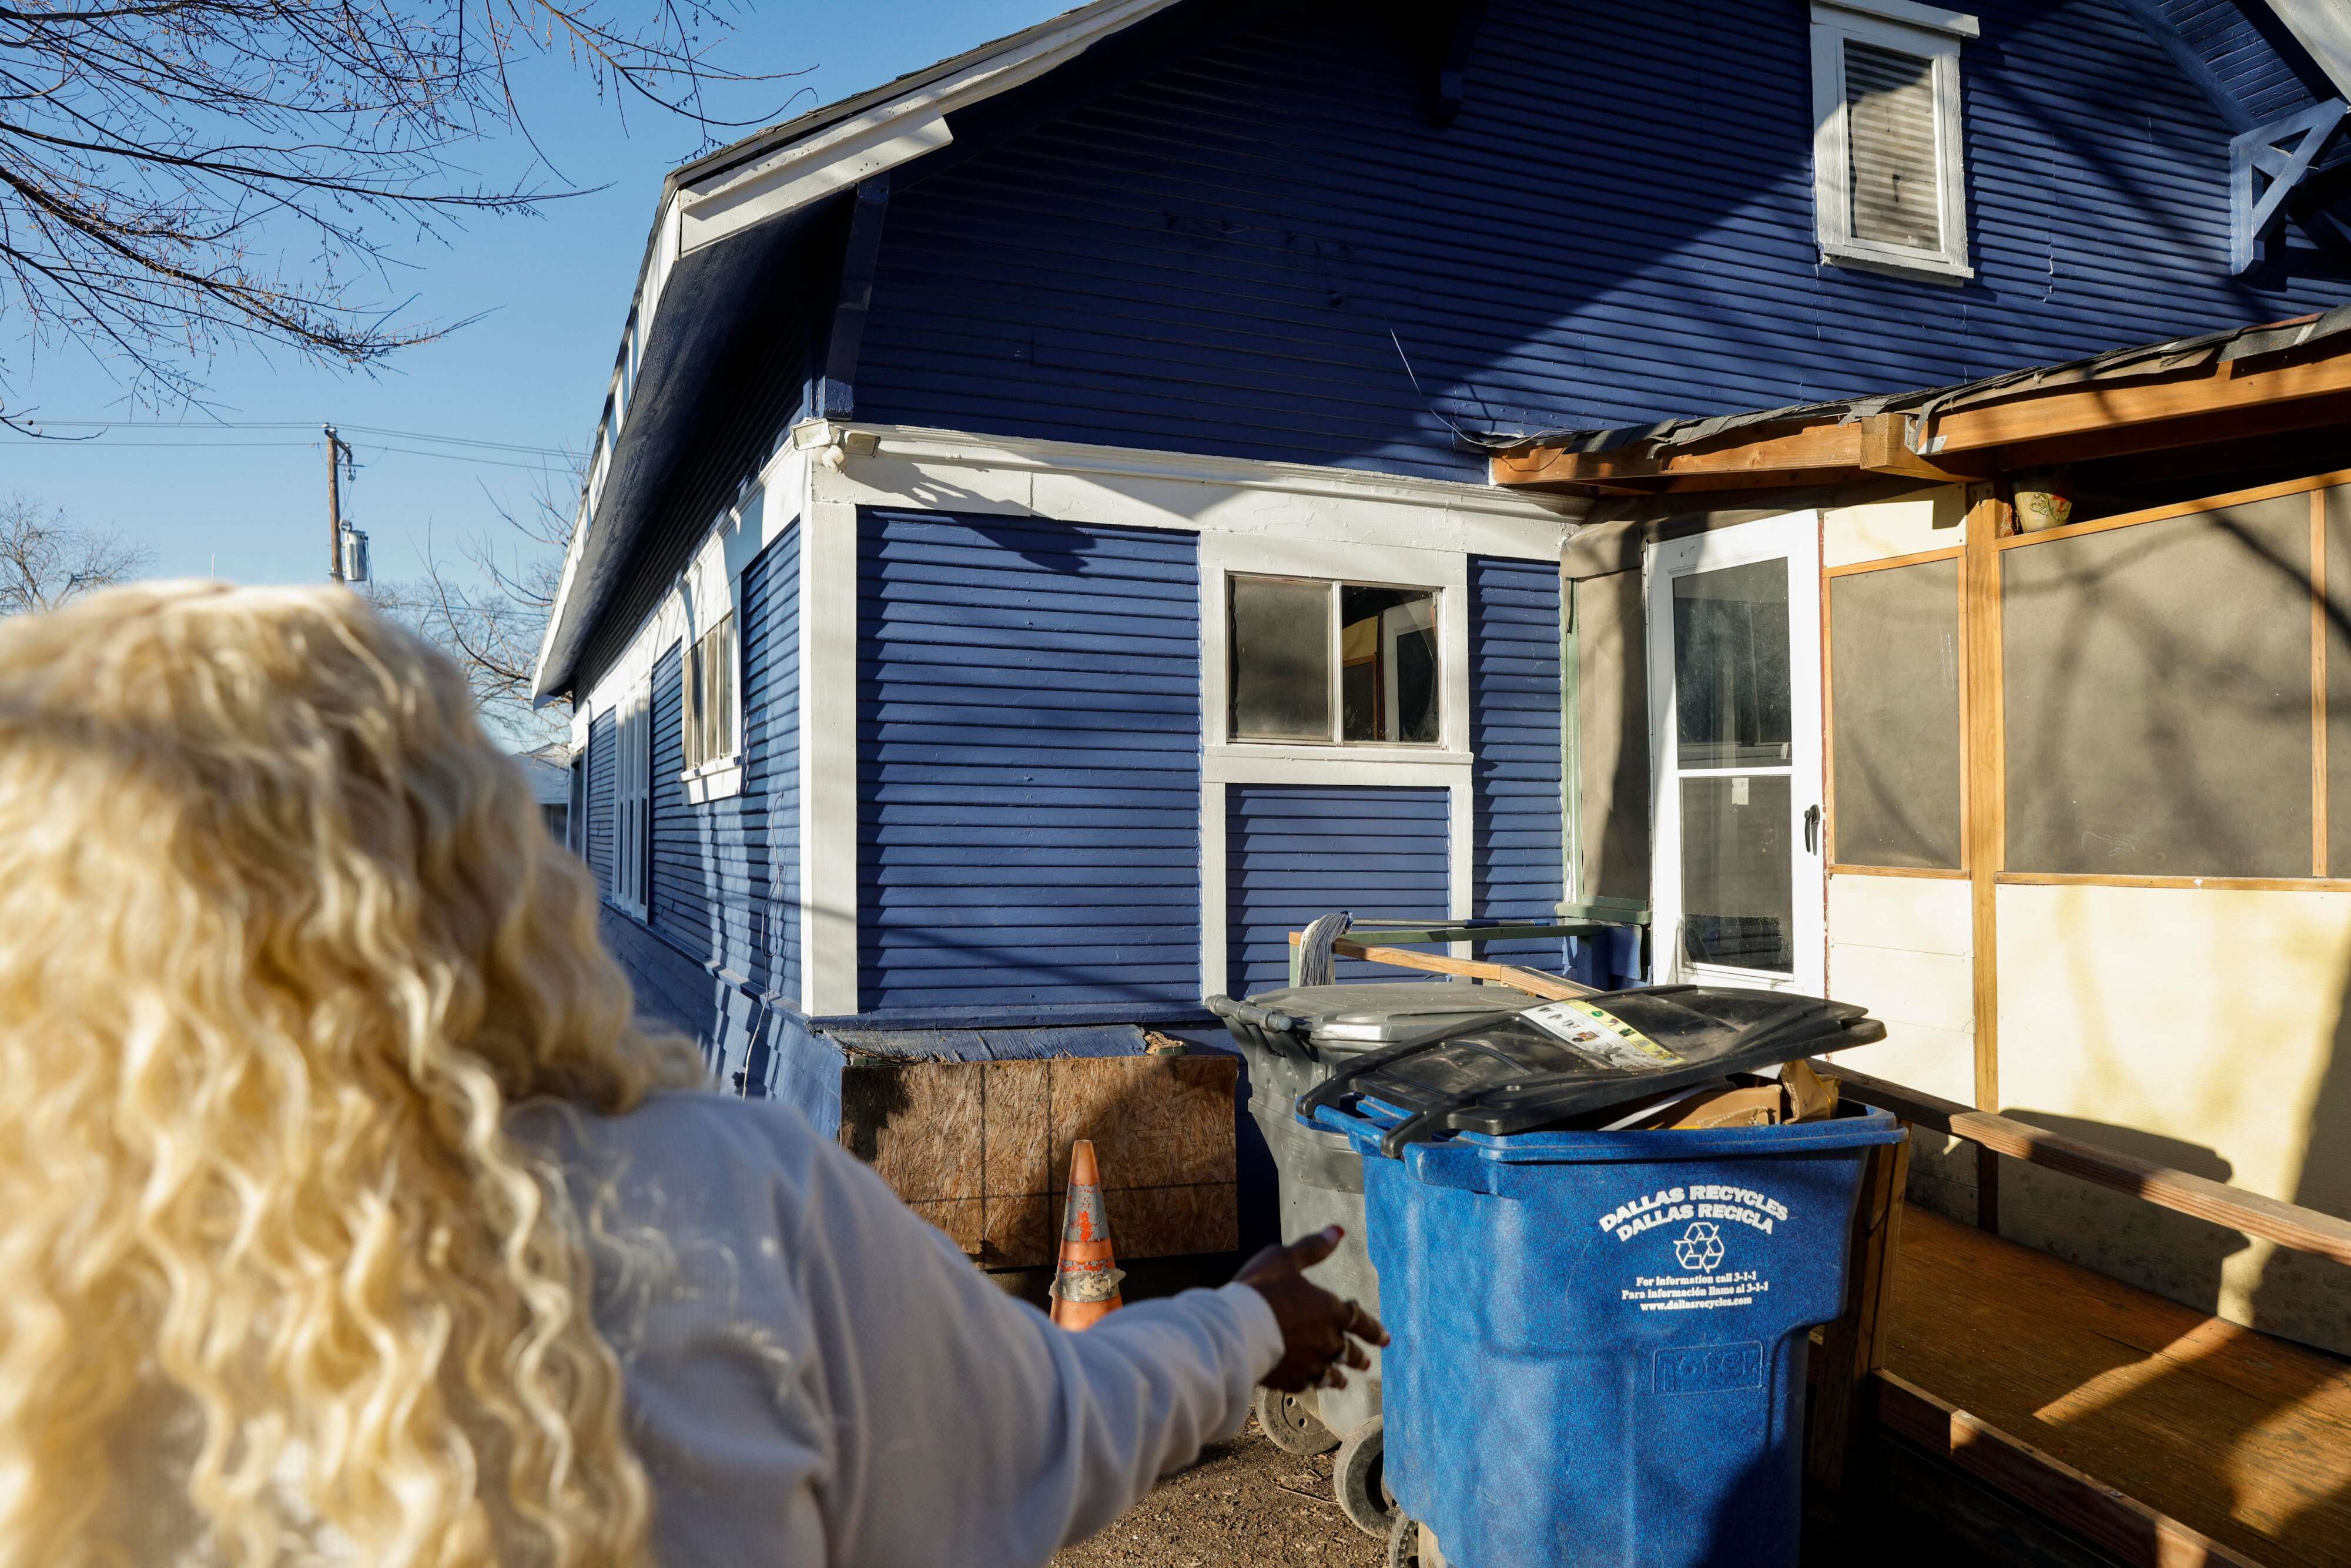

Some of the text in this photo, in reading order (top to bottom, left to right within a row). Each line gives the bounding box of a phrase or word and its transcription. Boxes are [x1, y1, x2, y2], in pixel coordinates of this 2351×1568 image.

[1599, 1185, 1788, 1232] DALLAS RECYCLES
[1616, 1203, 1773, 1242] DALLAS RECICLA
[1636, 1276, 1655, 1286] For
[1715, 1272, 1733, 1283] call
[1733, 1270, 1757, 1282] 3-1-1
[1622, 1289, 1646, 1300] Para
[1736, 1283, 1745, 1294] al
[1746, 1281, 1769, 1293] 3-1-1
[1640, 1296, 1752, 1311] www.dallasrecycles.com
